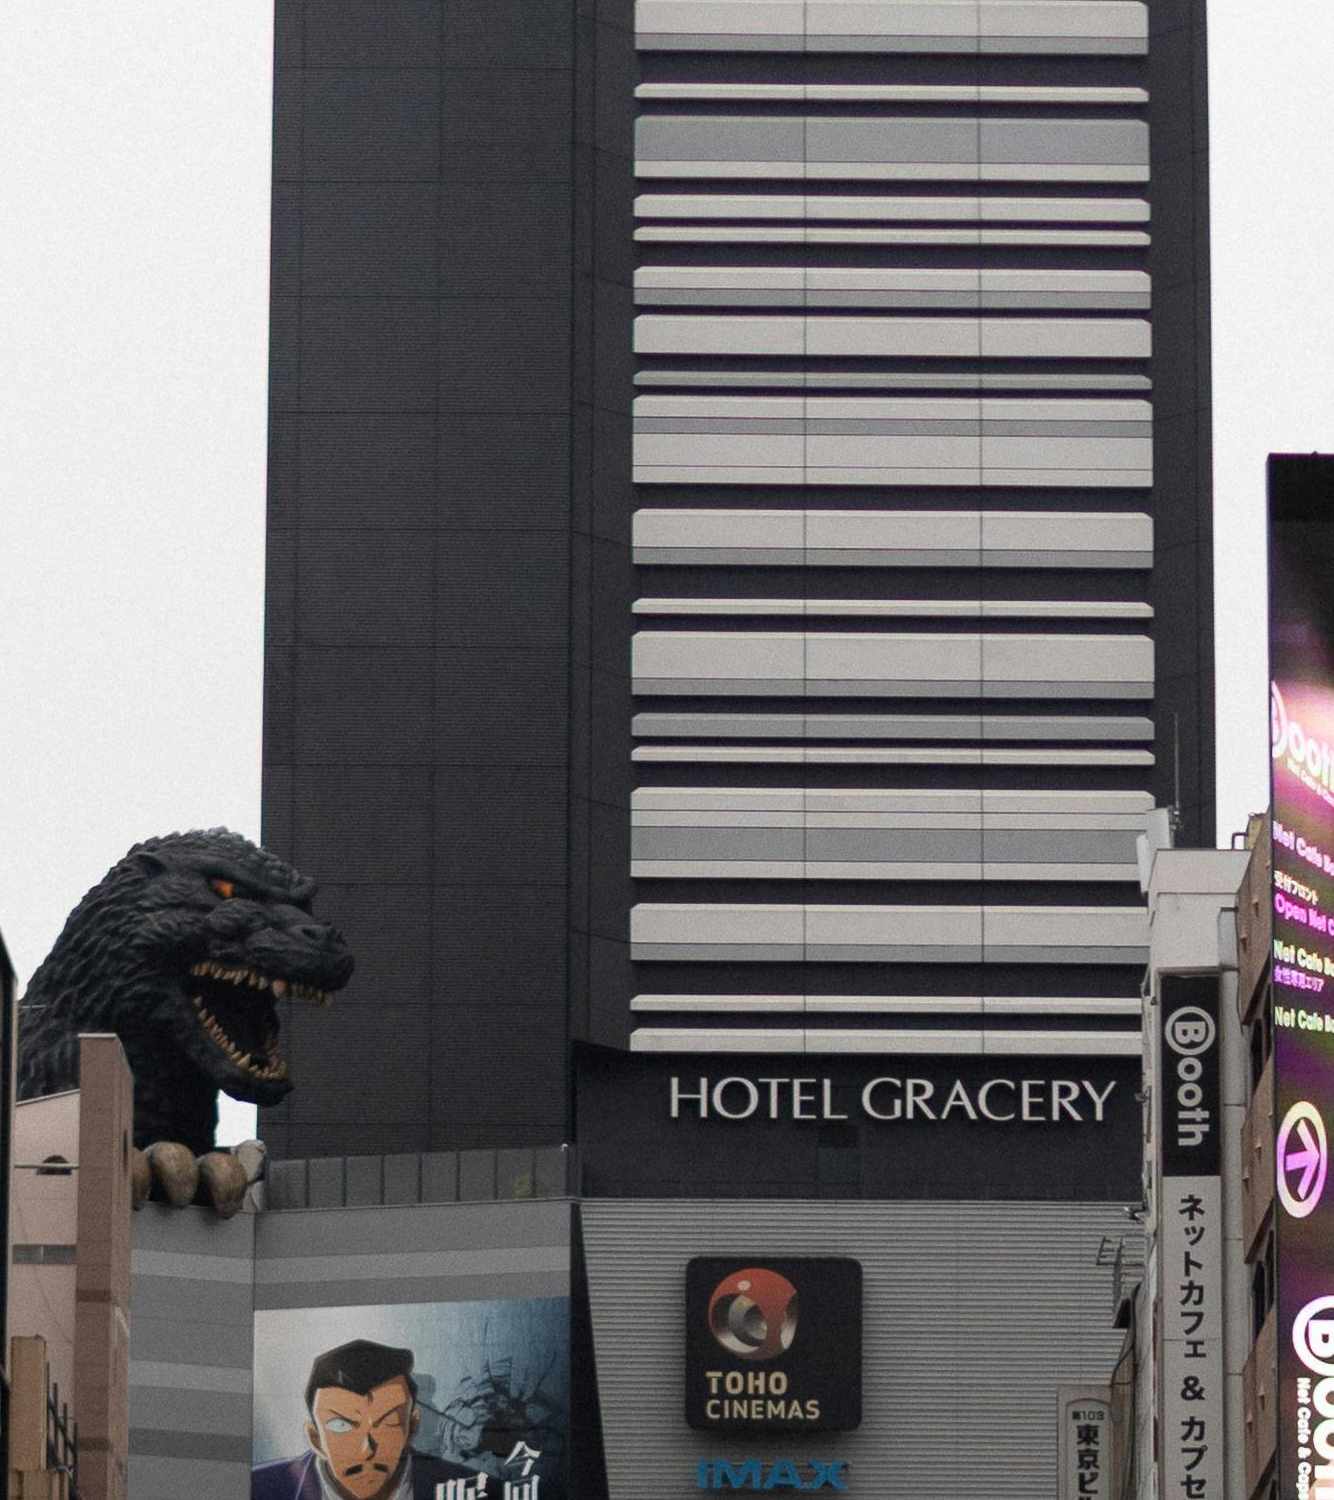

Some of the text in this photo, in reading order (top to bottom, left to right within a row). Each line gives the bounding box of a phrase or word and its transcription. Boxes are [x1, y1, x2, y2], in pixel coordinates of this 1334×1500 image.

[1274, 1006, 1324, 1032] Net Cafe
[1165, 1004, 1218, 1148] Booth
[670, 1076, 1117, 1123] HOTEL GRACERY
[1178, 1193, 1209, 1360] ネットカフェ
[705, 1372, 789, 1395] TOHO
[1179, 1374, 1208, 1402] &
[704, 1399, 821, 1421] CINEMAS
[695, 1458, 851, 1493] IMAX
